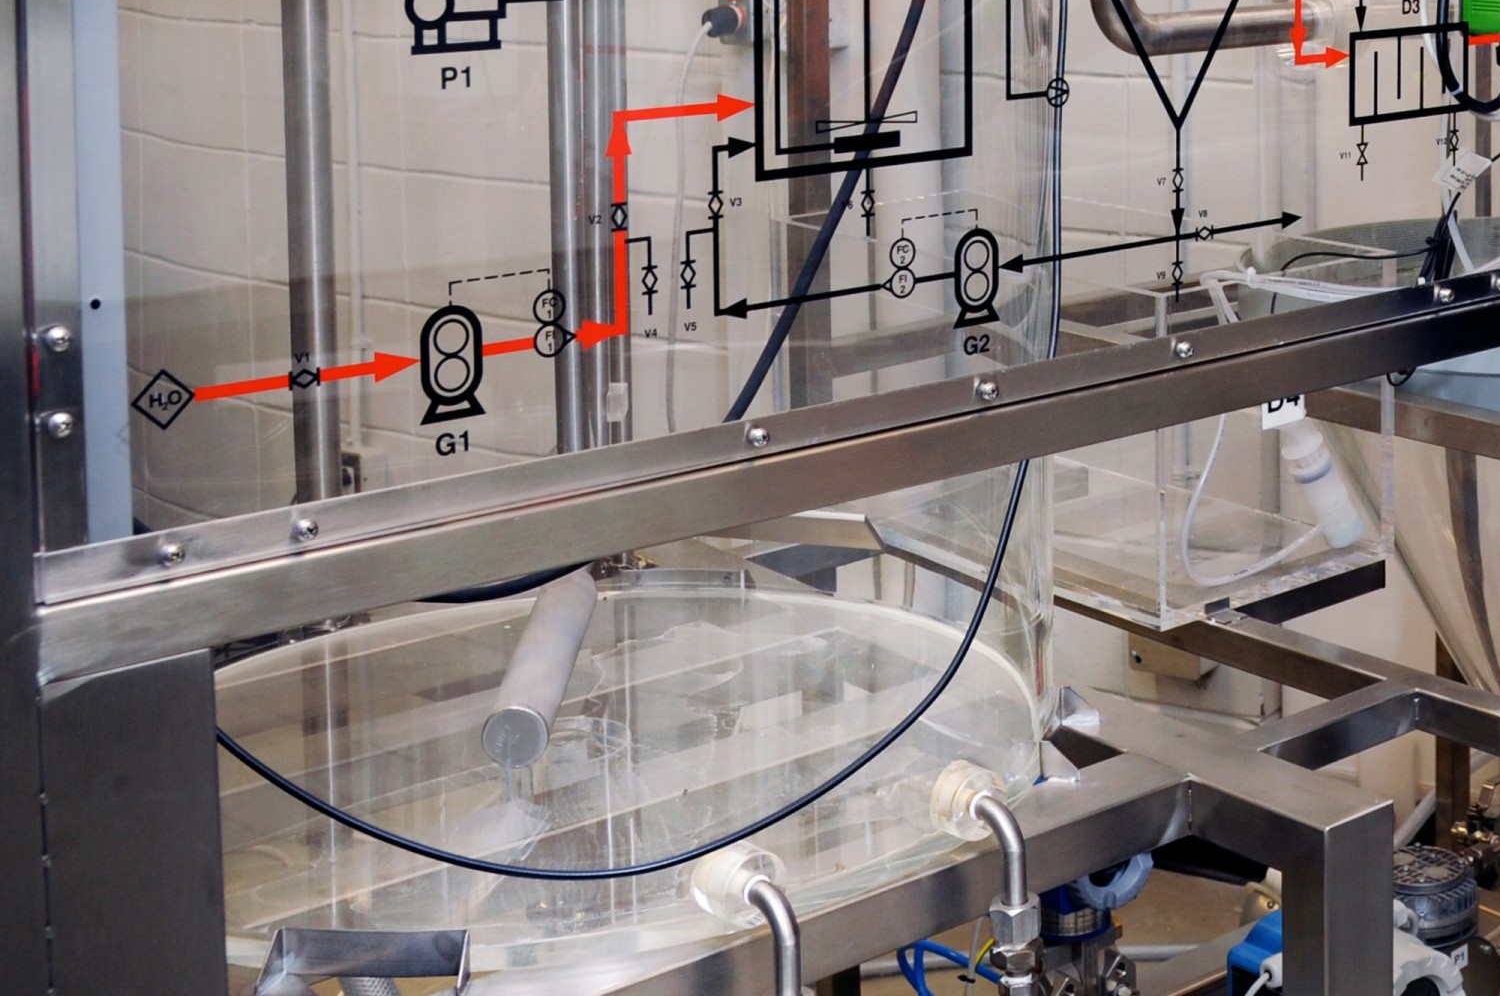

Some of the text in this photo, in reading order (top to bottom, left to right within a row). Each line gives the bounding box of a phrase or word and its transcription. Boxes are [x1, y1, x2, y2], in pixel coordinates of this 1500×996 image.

[441, 66, 471, 90] P1
[1156, 177, 1167, 186] V7
[729, 197, 742, 207] V3
[1198, 210, 1208, 218] V8
[588, 215, 603, 225] V2
[896, 245, 909, 255] FC
[900, 256, 906, 265] 2
[898, 275, 907, 284] FI
[1156, 270, 1166, 281] V9
[900, 285, 906, 294] 2
[541, 296, 557, 308] FC
[684, 322, 697, 332] V5
[644, 329, 657, 339] V4
[963, 333, 990, 356] G2
[295, 352, 309, 364] V1
[435, 429, 469, 457] G1
[1454, 950, 1465, 965] P1
